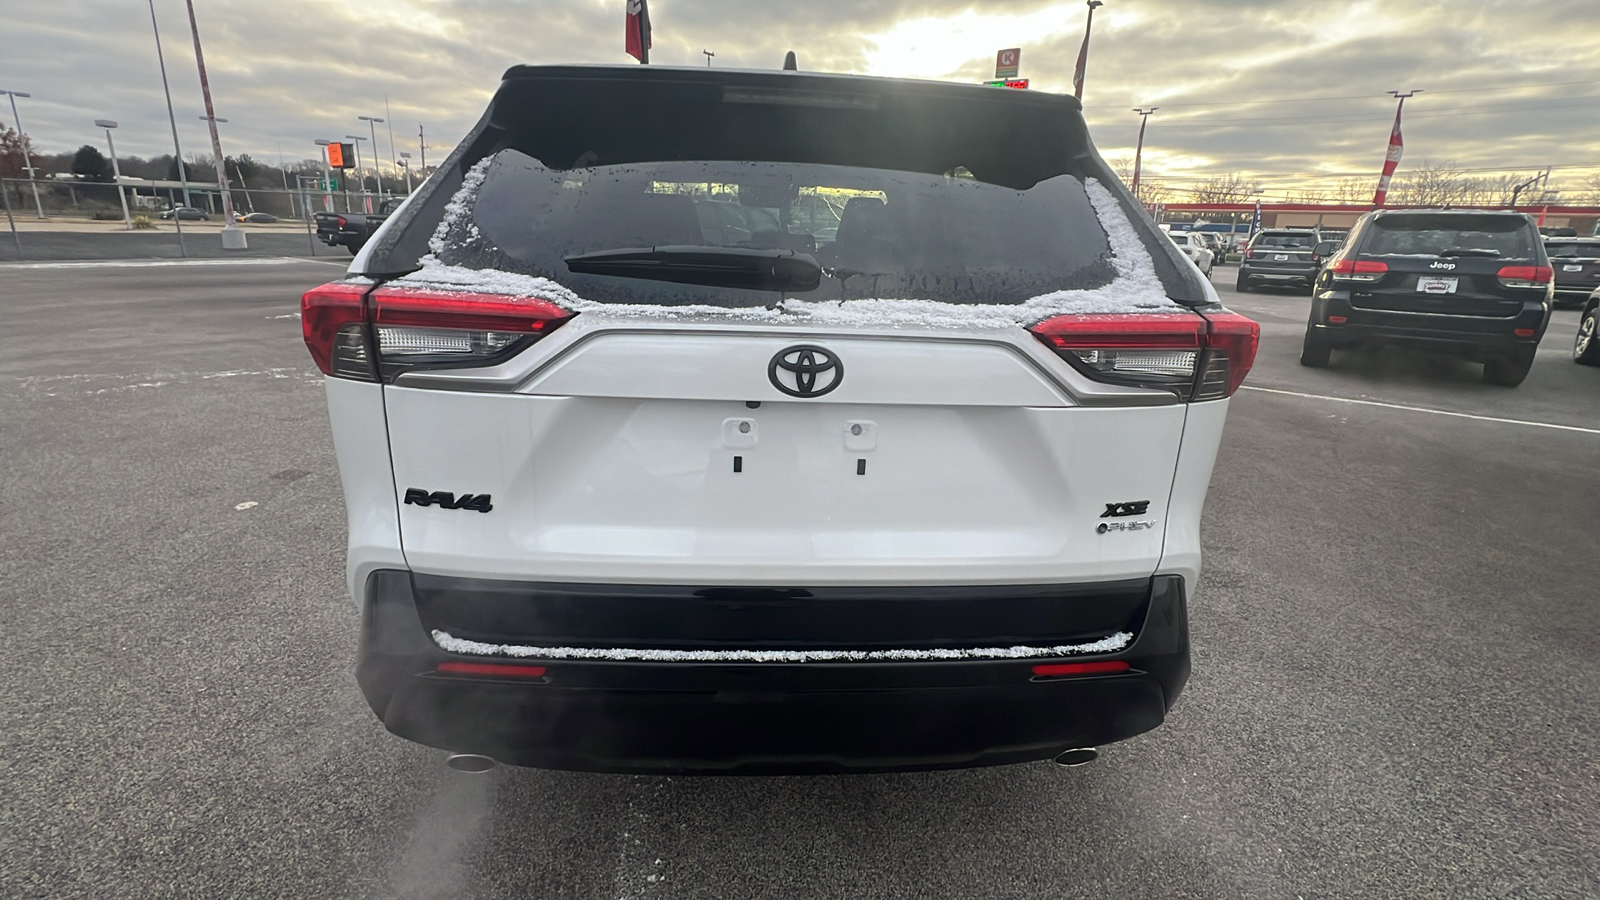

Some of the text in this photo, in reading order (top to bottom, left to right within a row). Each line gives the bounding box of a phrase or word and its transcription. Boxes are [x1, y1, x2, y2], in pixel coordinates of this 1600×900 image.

[1429, 261, 1456, 270] Jeep
[404, 487, 493, 513] RAV4
[1100, 500, 1151, 518] XSE
